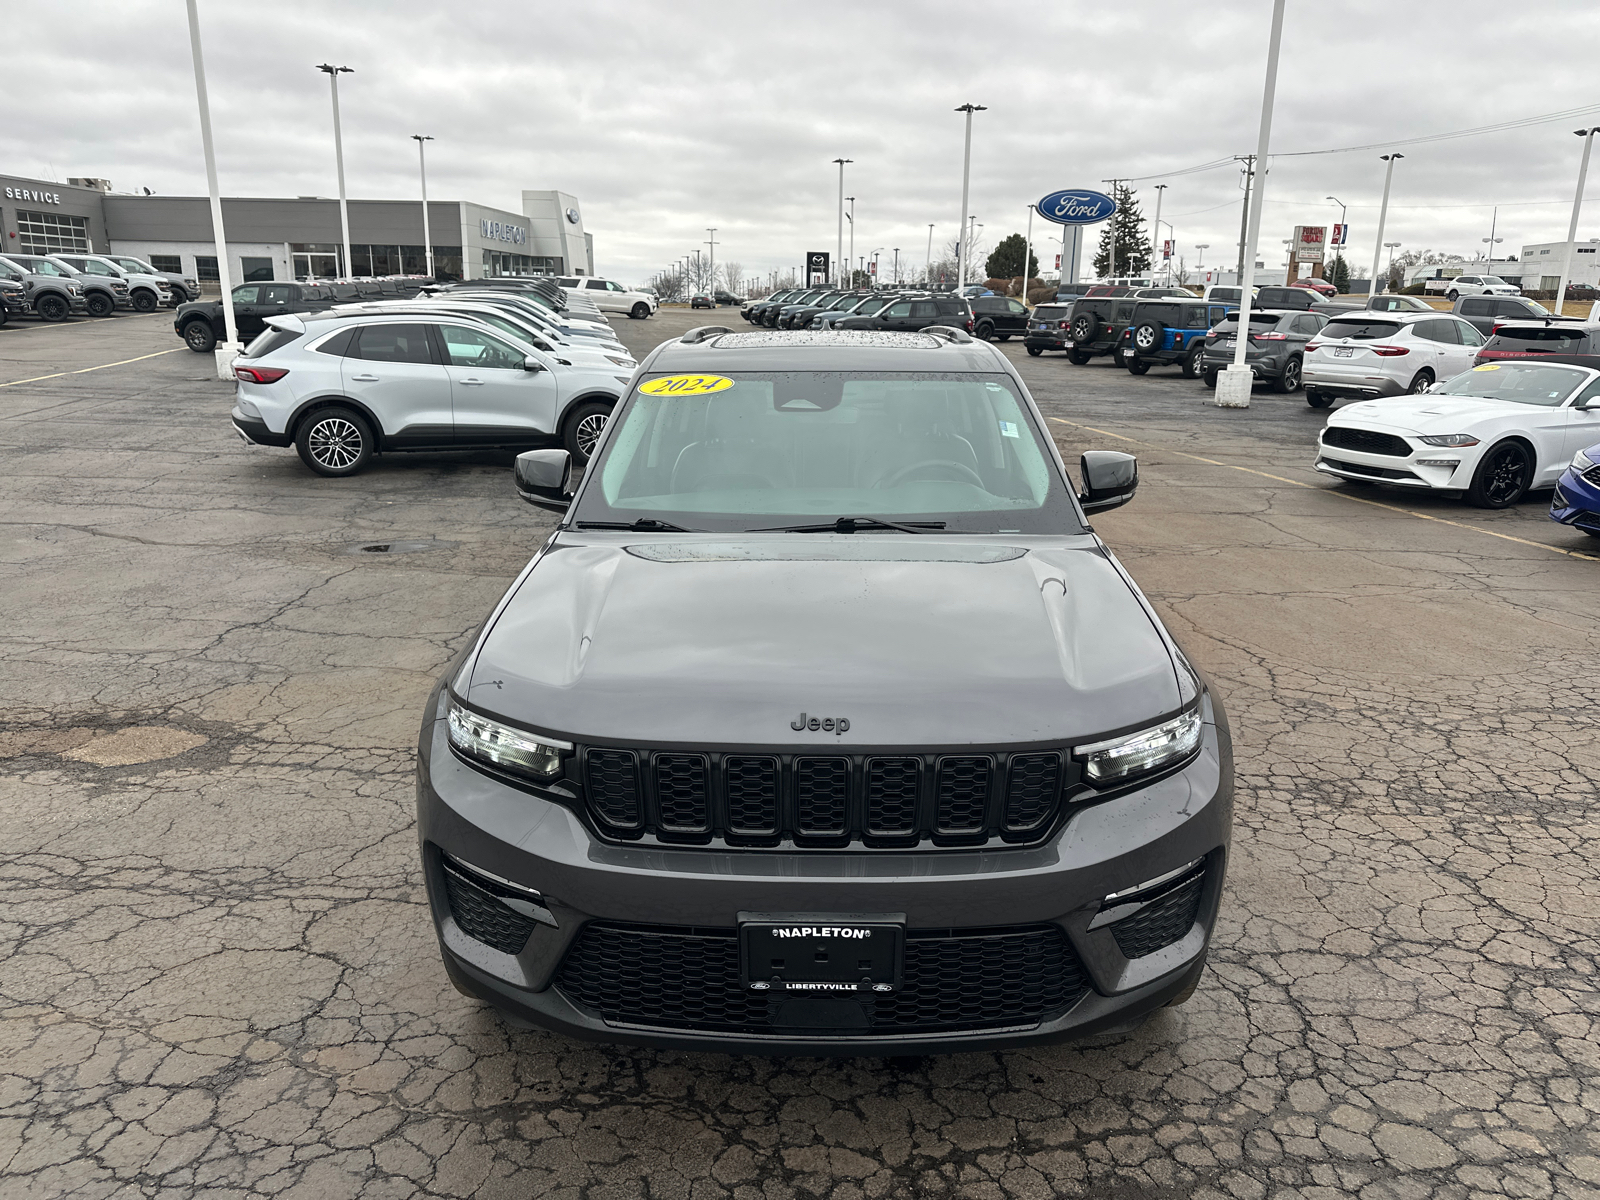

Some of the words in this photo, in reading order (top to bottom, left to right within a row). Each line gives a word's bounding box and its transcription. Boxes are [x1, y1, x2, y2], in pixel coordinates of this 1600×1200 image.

[5, 187, 60, 204] SERVICE
[1055, 195, 1102, 217] Ford
[481, 218, 526, 244] NAPLETON
[651, 379, 724, 393] 2024
[790, 713, 850, 735] Jeep
[779, 927, 864, 939] NAPLETON
